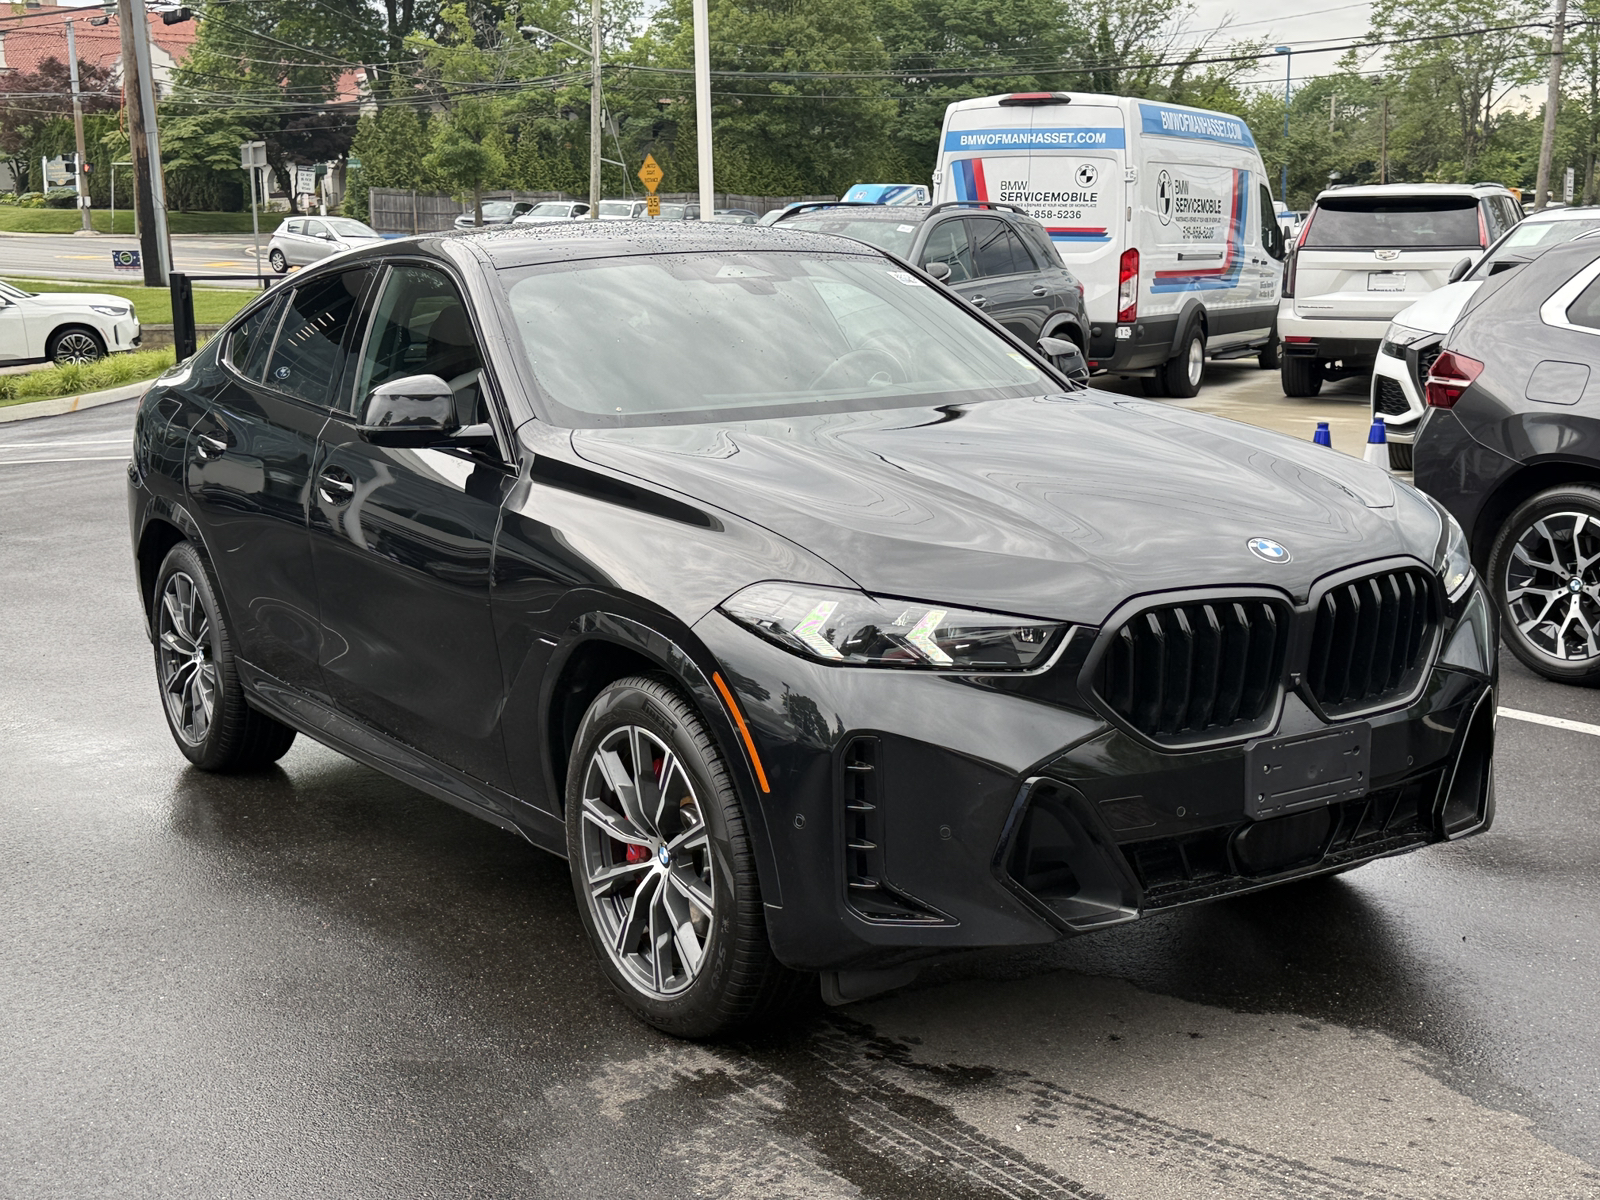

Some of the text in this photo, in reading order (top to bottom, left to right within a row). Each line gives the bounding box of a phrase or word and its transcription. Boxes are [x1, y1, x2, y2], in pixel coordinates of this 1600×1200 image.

[1160, 111, 1242, 140] BMWOFMANHASSET.COM
[960, 132, 1106, 146] BMWOFMANHASSET.COM
[1000, 181, 1028, 191] BMW
[1000, 192, 1098, 202] SERVICEMOBILE
[649, 198, 658, 207] 35
